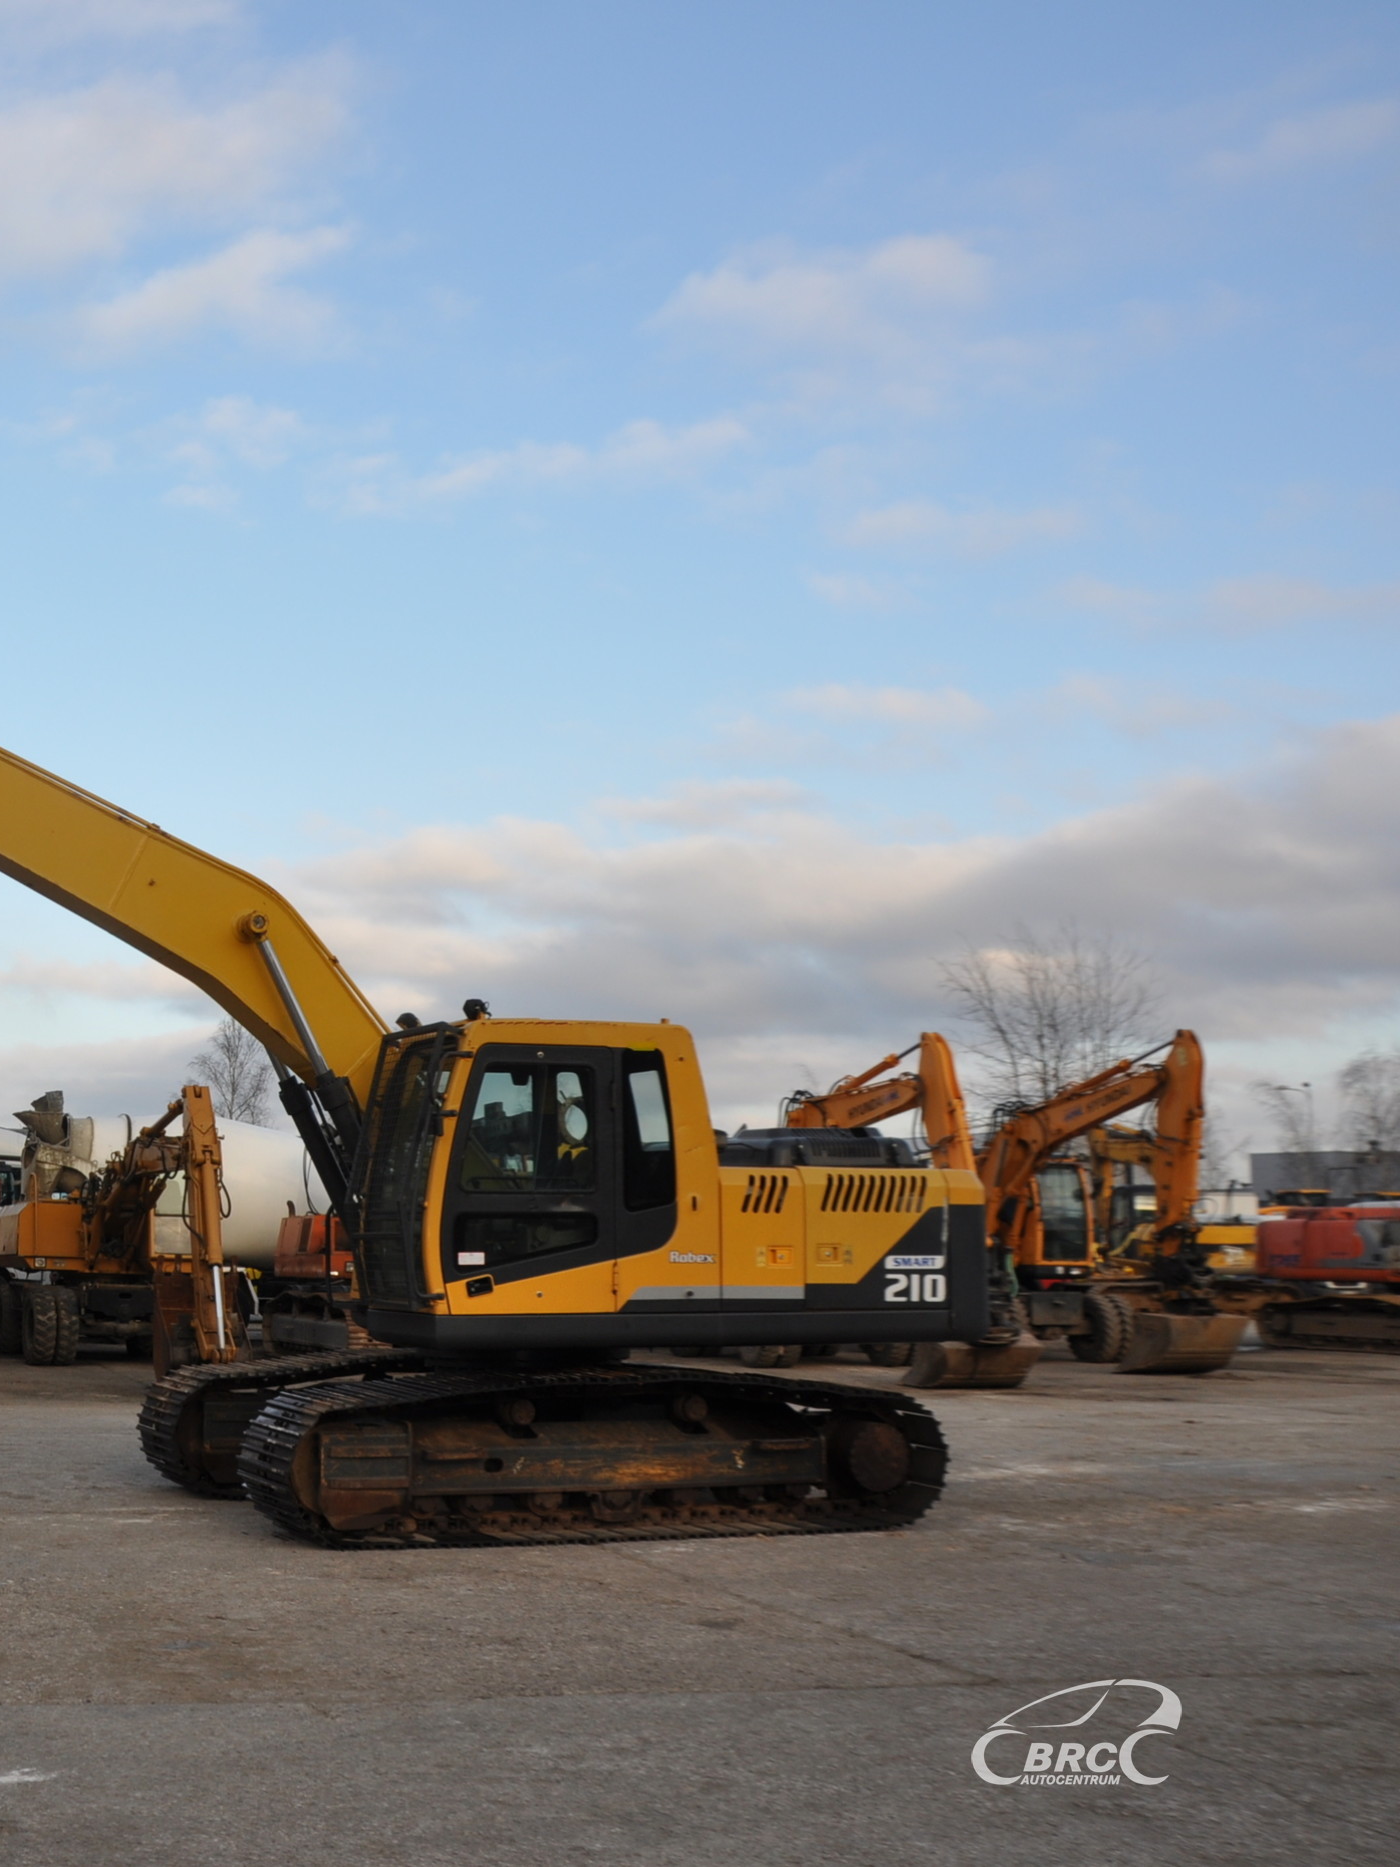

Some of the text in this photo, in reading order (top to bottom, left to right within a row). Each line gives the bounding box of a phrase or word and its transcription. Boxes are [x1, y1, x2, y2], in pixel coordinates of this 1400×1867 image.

[669, 1251, 715, 1263] Robex
[893, 1257, 936, 1267] SMART
[884, 1273, 947, 1302] 210
